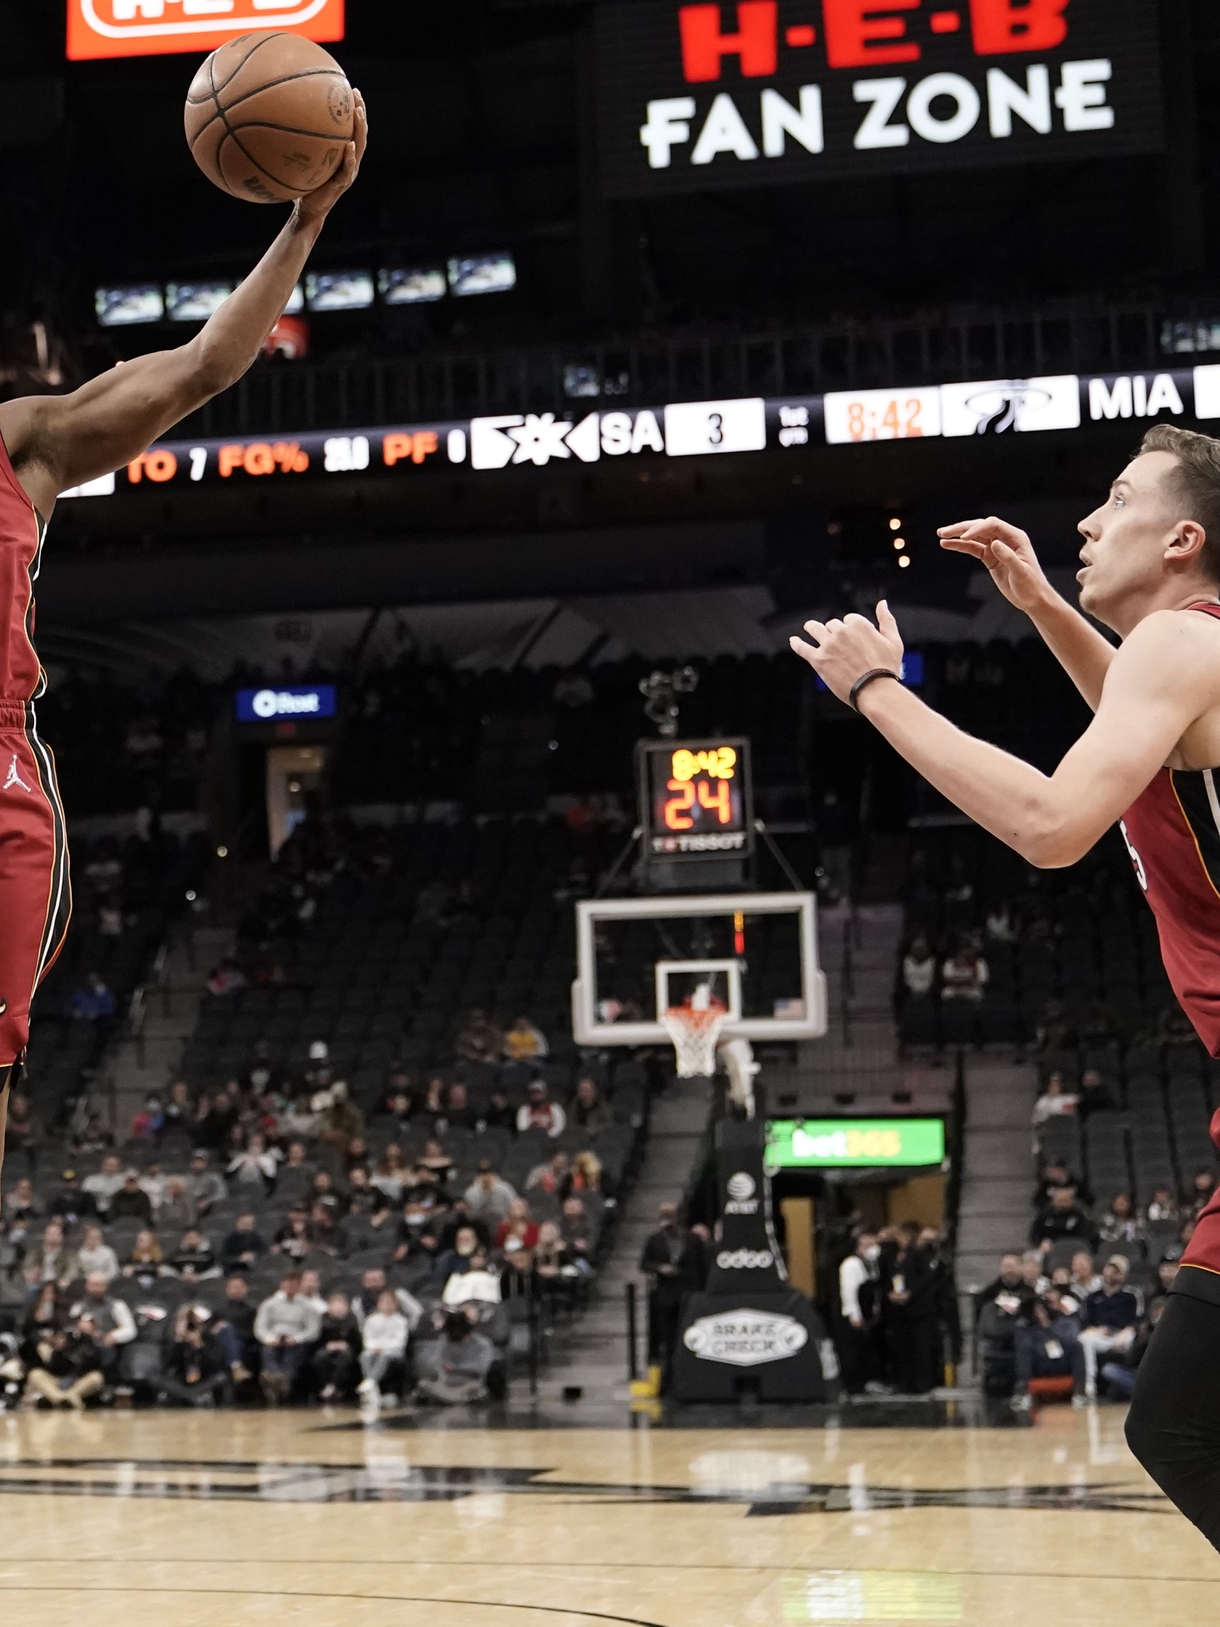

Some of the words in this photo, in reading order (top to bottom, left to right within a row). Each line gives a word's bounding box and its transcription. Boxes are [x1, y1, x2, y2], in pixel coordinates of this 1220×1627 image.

[640, 84, 824, 168] FAN
[852, 59, 1115, 150] ZONE
[847, 398, 923, 441] 8:42
[1089, 373, 1184, 420] MIA
[600, 410, 664, 455] SA
[708, 413, 724, 444] 3
[128, 449, 177, 484] TO
[218, 441, 309, 478] FG%
[383, 430, 439, 466] PF
[672, 746, 737, 781] 8:42
[664, 779, 731, 830] 24
[716, 1246, 774, 1269] odoo
